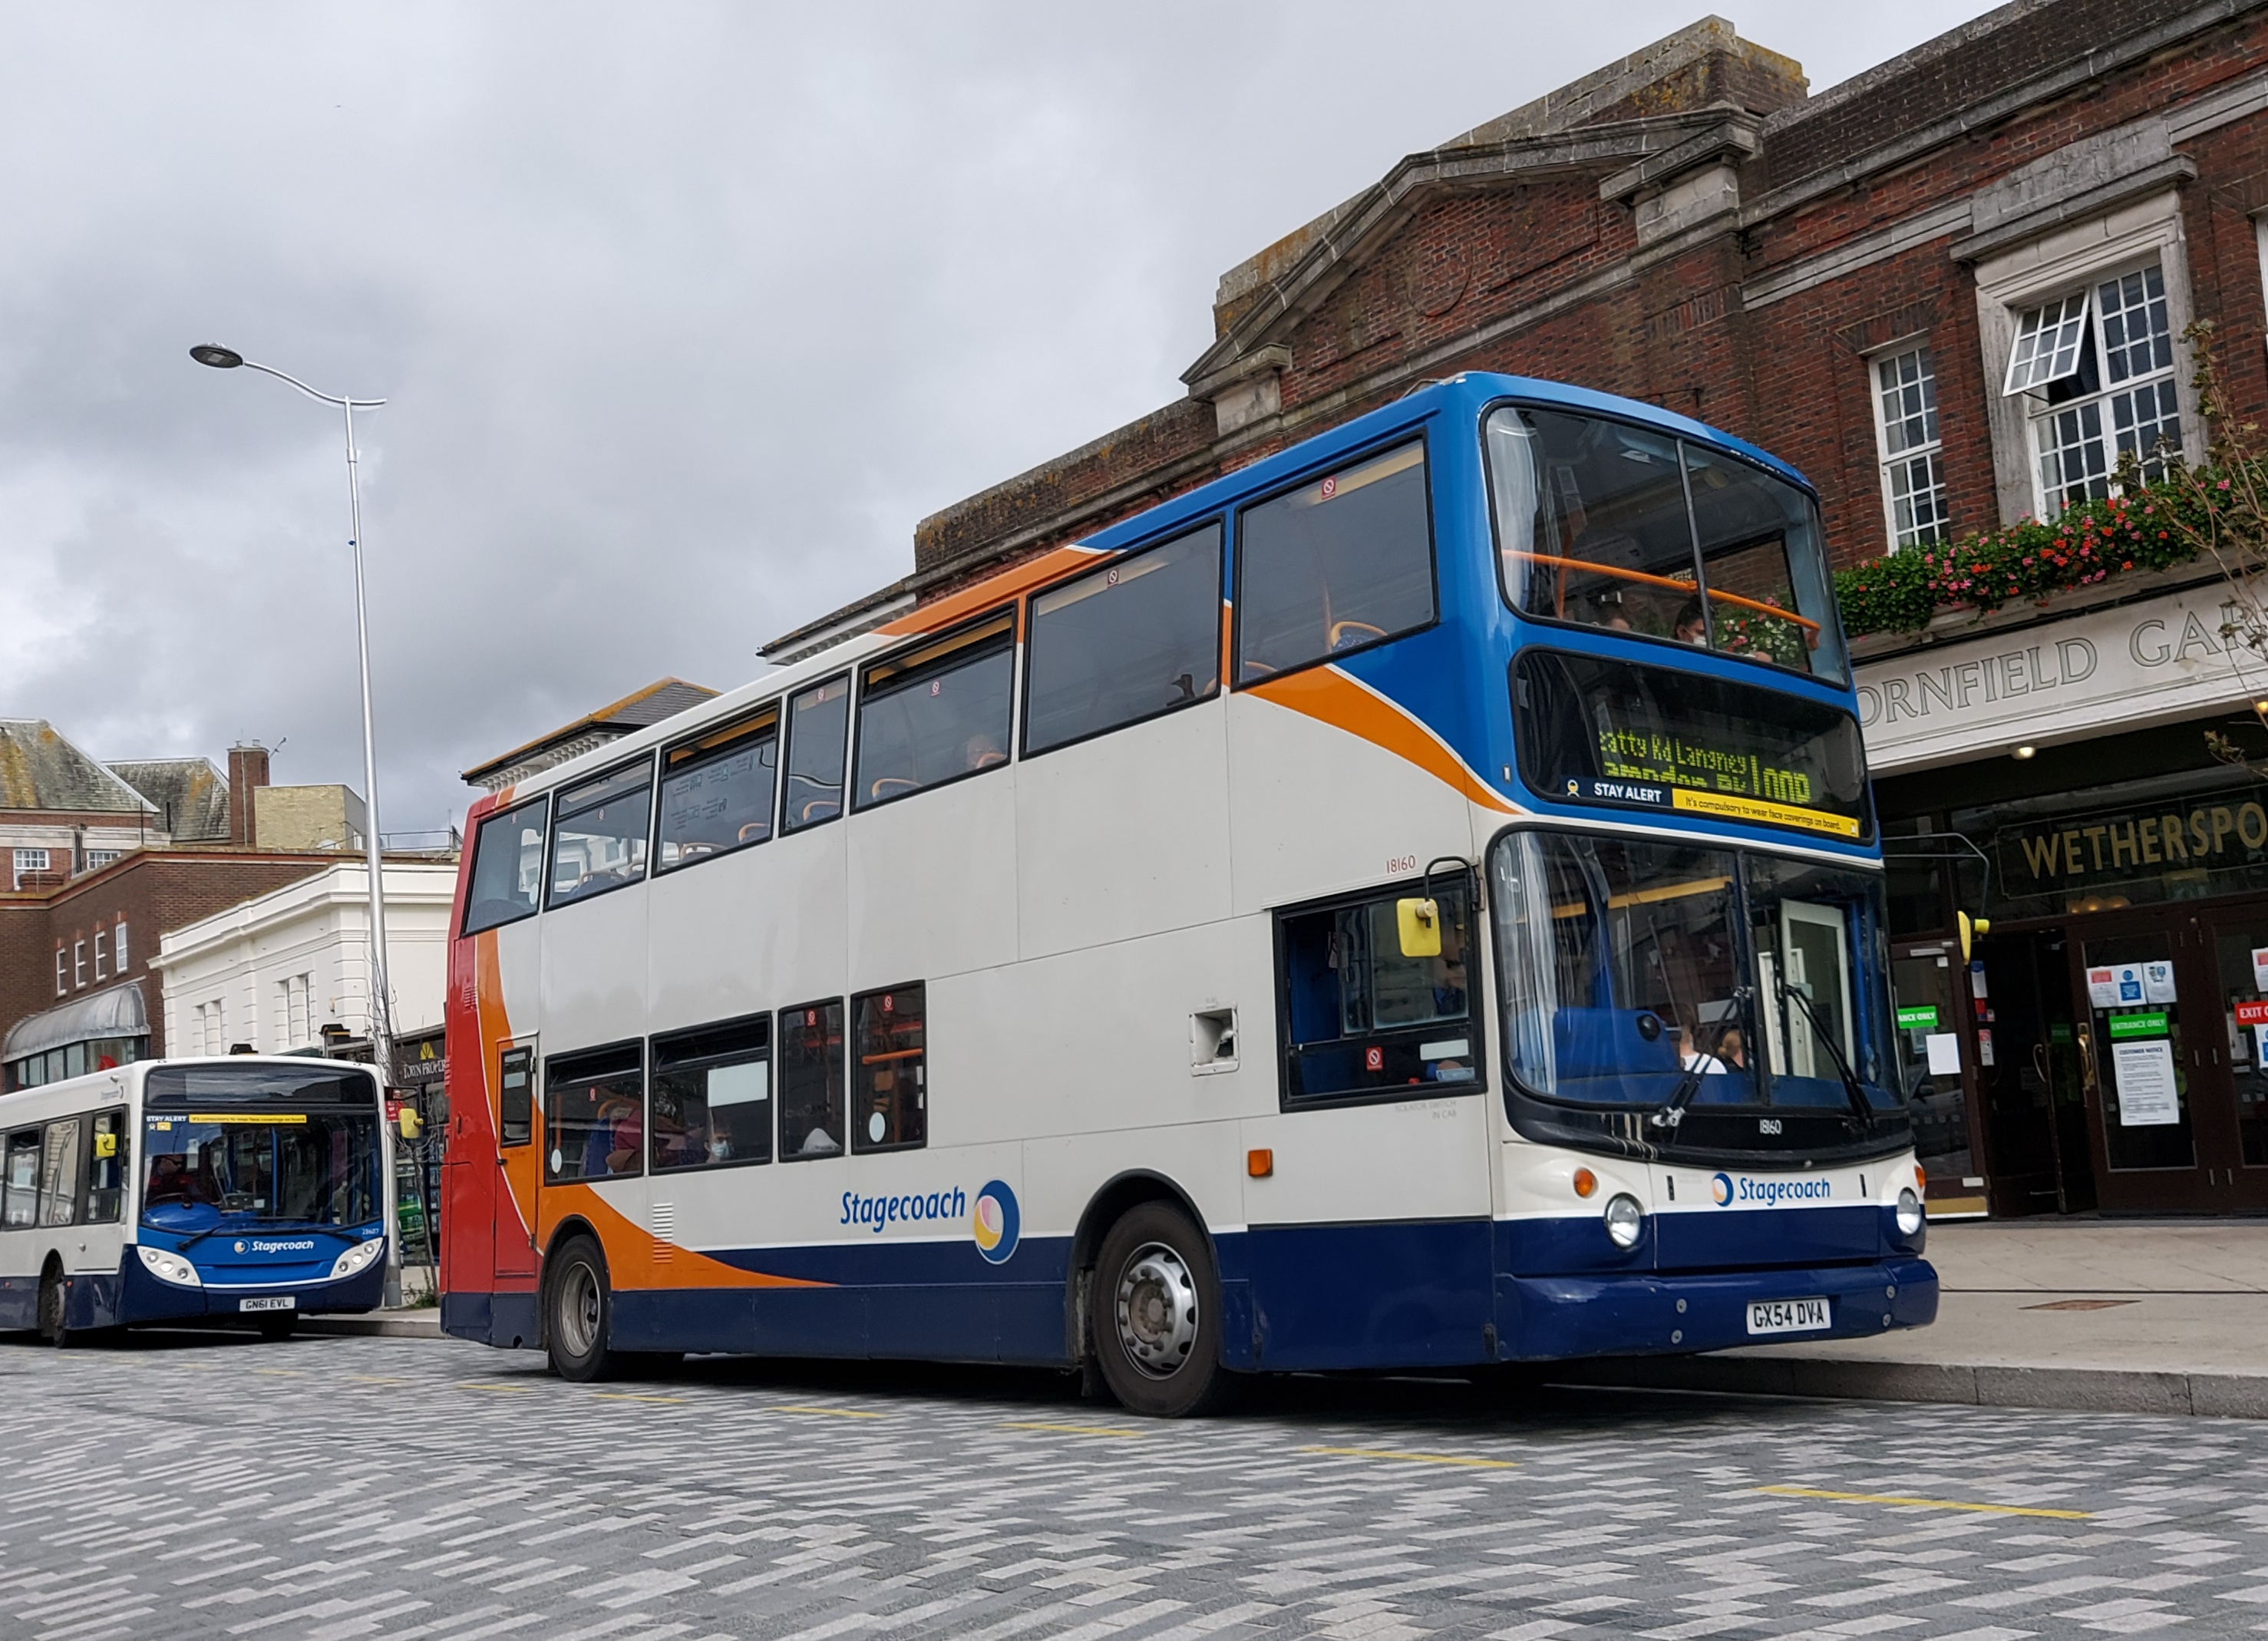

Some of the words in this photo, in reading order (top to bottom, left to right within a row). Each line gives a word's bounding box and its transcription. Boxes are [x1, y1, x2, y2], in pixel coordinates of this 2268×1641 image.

[1675, 738, 1748, 775] Langney
[1594, 782, 1624, 797] STAY
[1625, 786, 1662, 802] ALERT
[1685, 797, 1697, 807] It's
[1699, 797, 1741, 815] compulsory
[1742, 806, 1750, 814] to
[2021, 801, 2268, 880] WETHERSPO
[1386, 854, 1417, 873] 18160
[1916, 1012, 1936, 1021] ONLY
[2239, 1006, 2263, 1019] EXIT
[1758, 1119, 1783, 1135] 18160
[1739, 1177, 1831, 1207] Stagecoach
[840, 1185, 966, 1233] Stagecoach
[251, 1240, 315, 1254] Stagecoach
[246, 1299, 268, 1310] GN61
[270, 1299, 289, 1309] EVL
[1754, 1303, 1793, 1327] GX54
[1797, 1302, 1824, 1325] DVA
